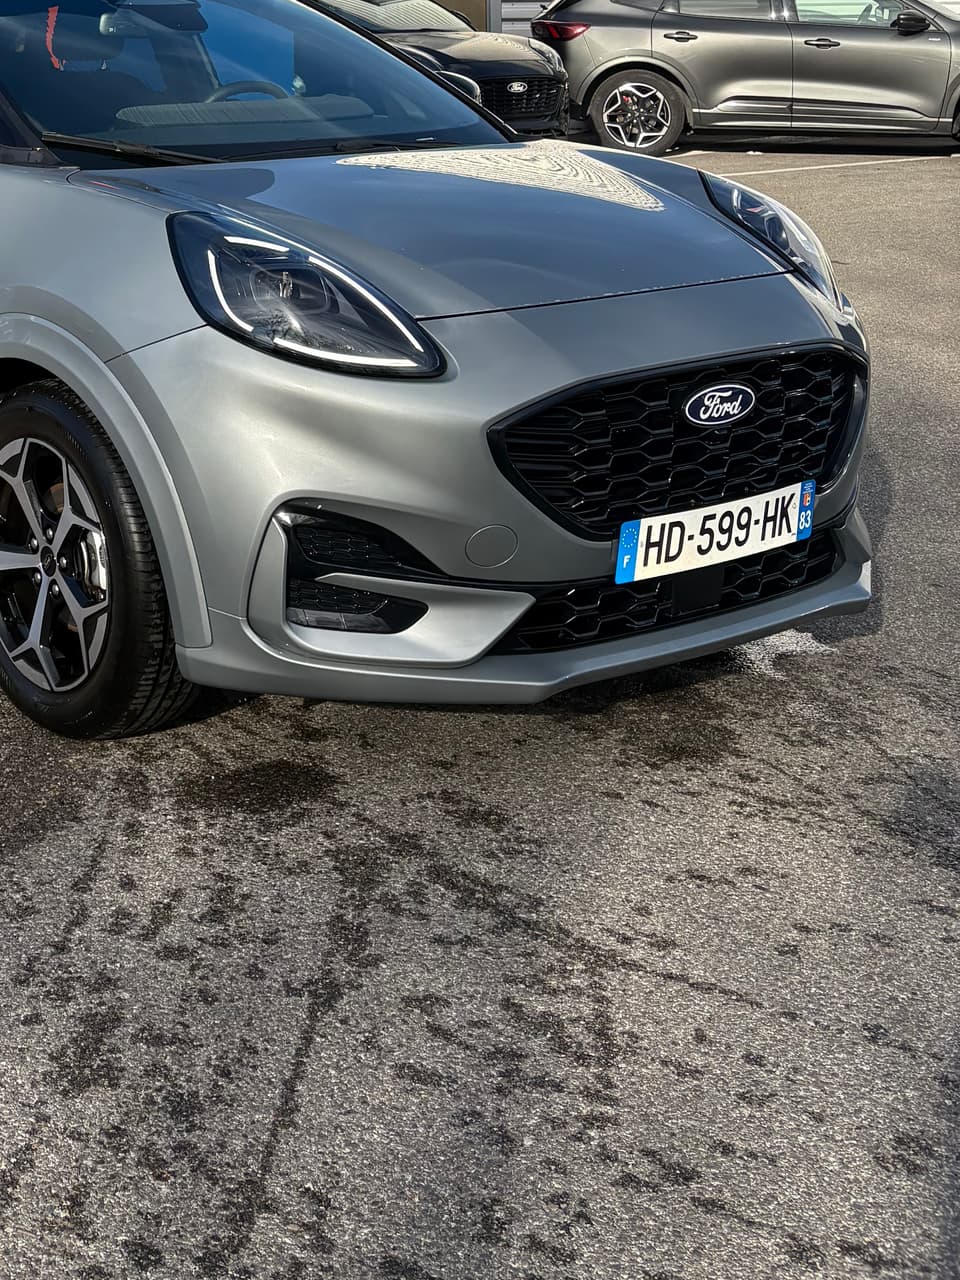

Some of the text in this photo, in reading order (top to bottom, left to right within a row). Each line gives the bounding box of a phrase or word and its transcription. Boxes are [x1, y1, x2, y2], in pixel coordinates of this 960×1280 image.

[700, 390, 743, 420] Ford
[623, 492, 811, 569] F HD-599-HK 83
